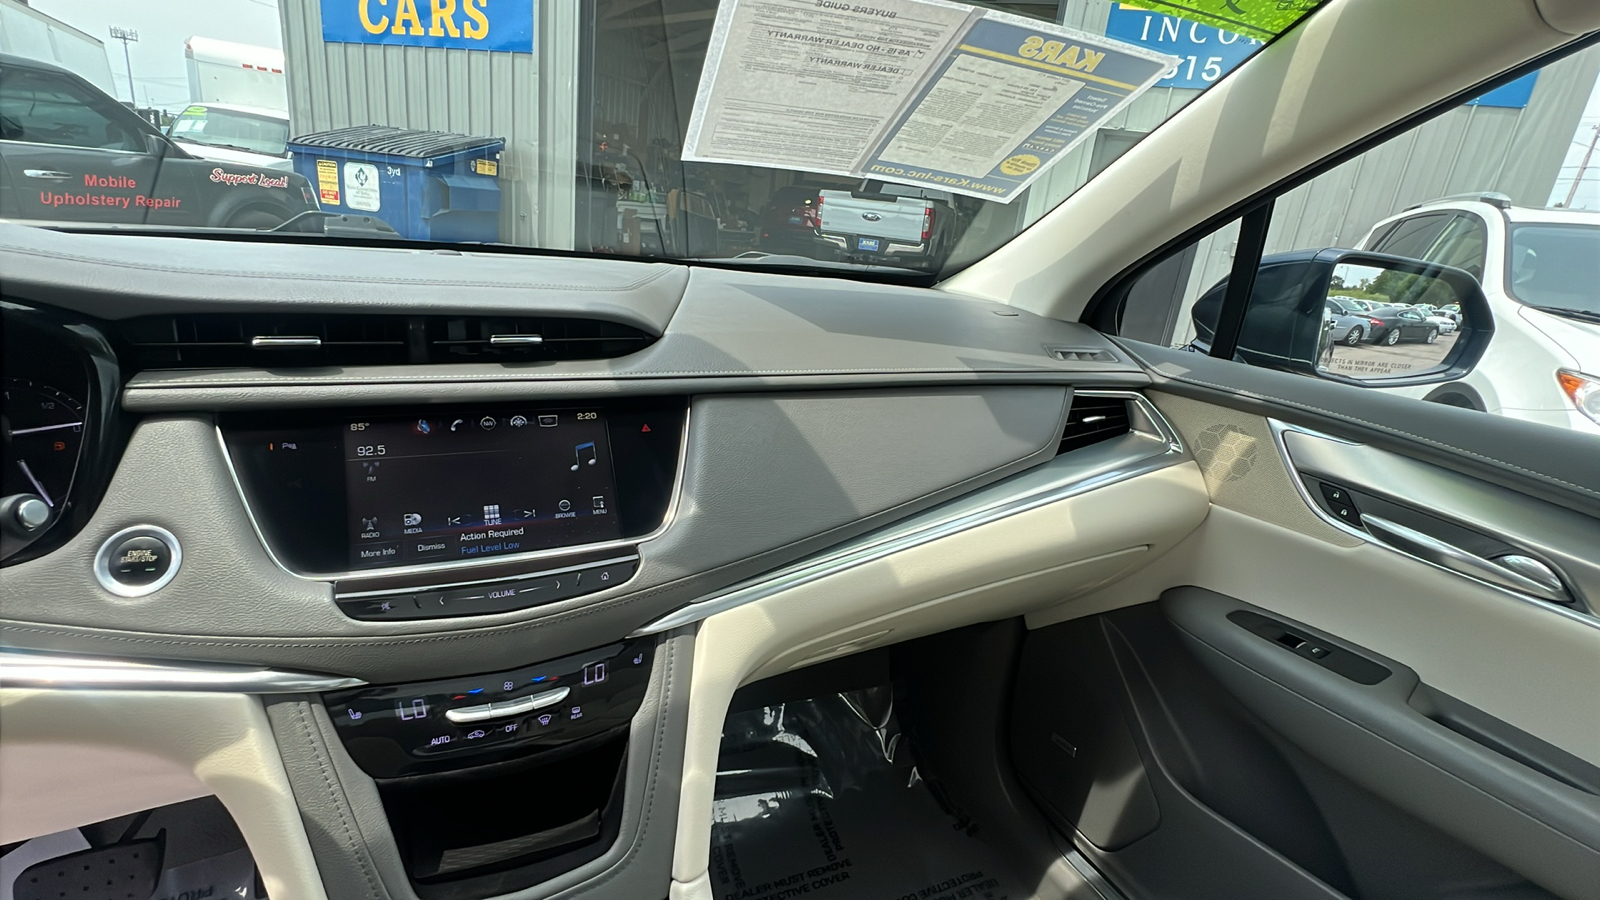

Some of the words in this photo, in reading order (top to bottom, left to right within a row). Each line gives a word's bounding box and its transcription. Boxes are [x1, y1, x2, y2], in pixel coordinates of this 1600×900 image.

[358, 0, 489, 40] CARS
[84, 174, 136, 188] Mobile
[210, 168, 258, 186] Support
[258, 173, 288, 188] Local!
[40, 192, 130, 208] Upholstery
[135, 195, 181, 209] Repair
[577, 412, 597, 420] 2:20
[350, 423, 370, 431] 85°
[357, 445, 386, 456] 92.5
[484, 518, 502, 526] TUNE
[460, 530, 486, 542] Action
[488, 527, 524, 540] Required
[127, 549, 152, 557] ENGINE
[361, 550, 381, 558] More
[382, 548, 396, 556] Info
[417, 543, 446, 552] Dismiss
[461, 546, 478, 554] Fuel
[481, 543, 501, 553] Level
[503, 541, 520, 551] Low
[488, 589, 516, 599] VOLUME
[584, 663, 605, 685] LO
[400, 699, 427, 721] LO
[505, 724, 518, 733] OFF
[431, 735, 450, 746] AUTO
[725, 881, 773, 900] DEALER
[774, 872, 806, 890] MUST
[806, 858, 853, 879] REMOVE
[811, 871, 851, 890] COVER
